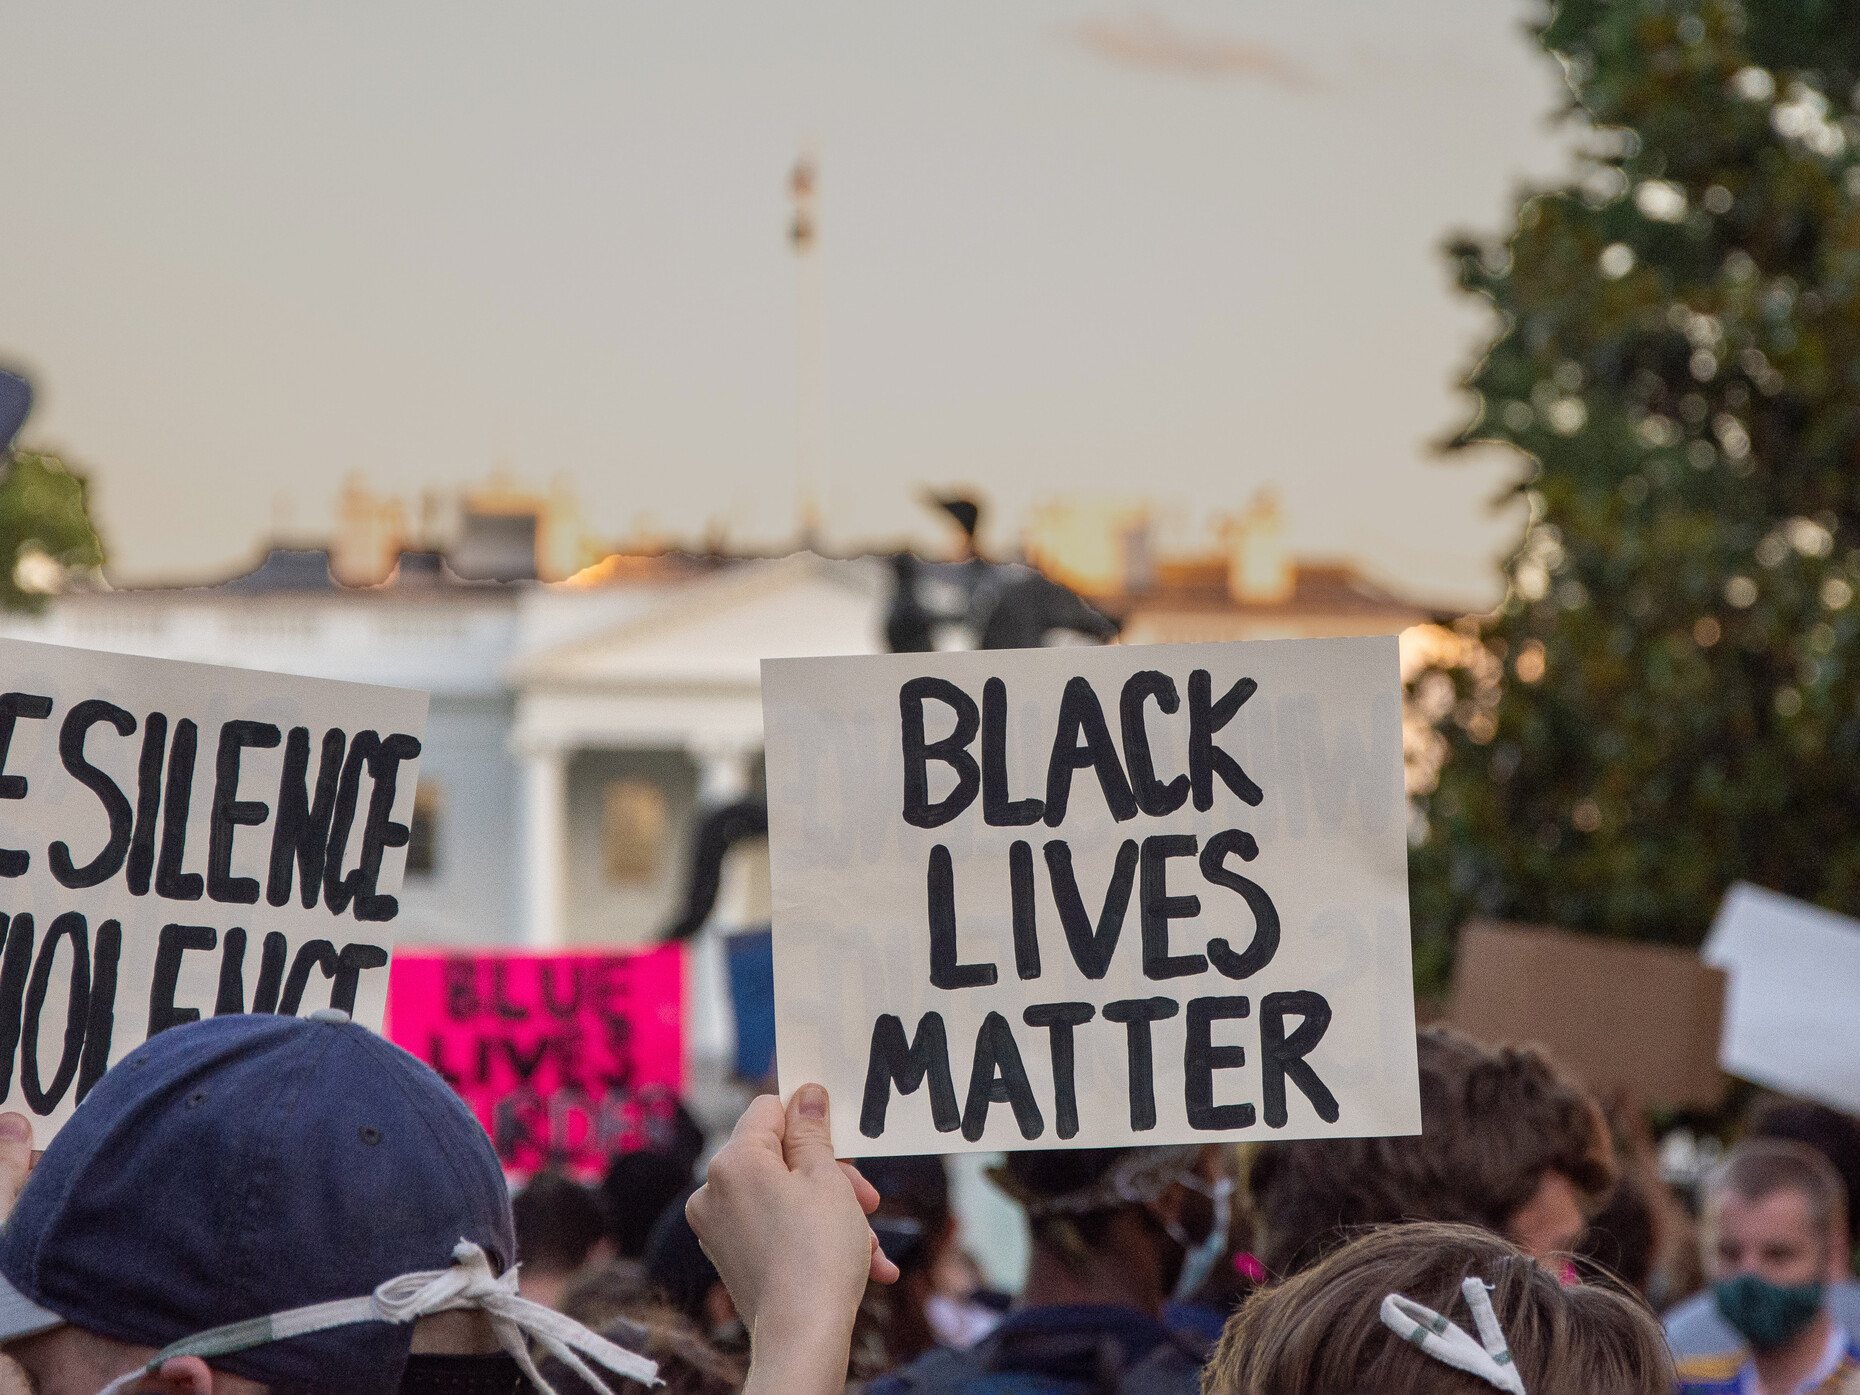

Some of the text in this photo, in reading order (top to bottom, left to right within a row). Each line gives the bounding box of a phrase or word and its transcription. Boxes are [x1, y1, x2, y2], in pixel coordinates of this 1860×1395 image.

[48, 699, 422, 922] SILENCE
[899, 669, 1265, 829] BLACK
[926, 828, 1281, 990] LIVES
[428, 1012, 635, 1088] LIVES
[443, 954, 631, 1021] BLUE
[858, 990, 1340, 1142] MATTER
